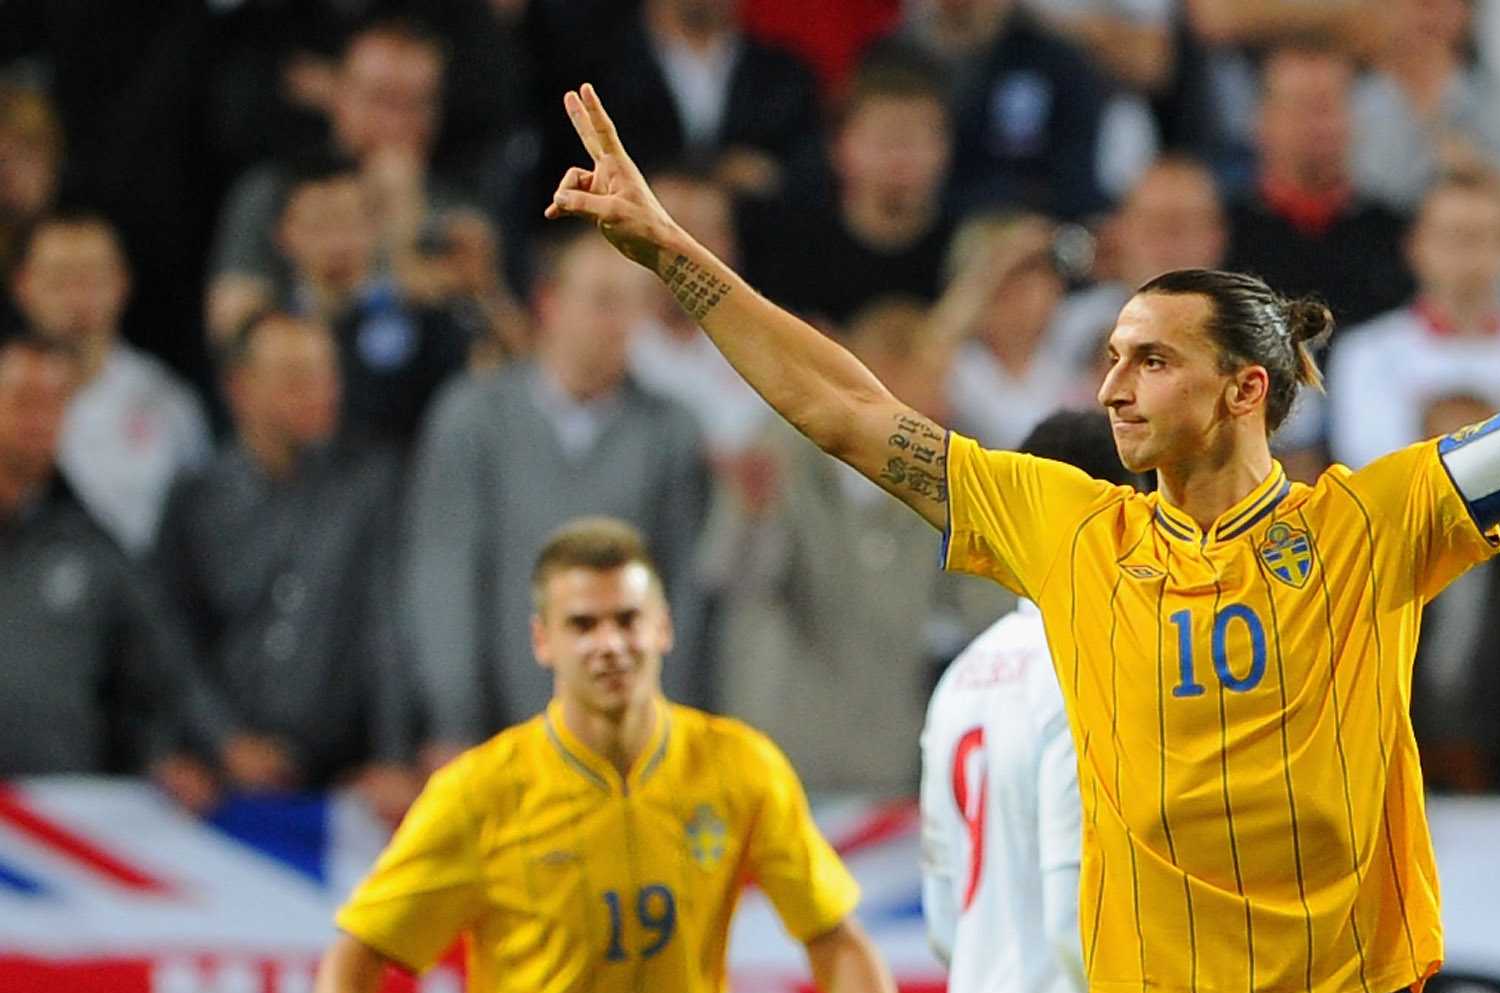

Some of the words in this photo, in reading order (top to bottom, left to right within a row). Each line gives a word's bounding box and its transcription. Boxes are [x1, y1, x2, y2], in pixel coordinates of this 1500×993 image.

[1169, 603, 1267, 697] 10
[953, 726, 987, 912] 9
[602, 884, 676, 961] 19
